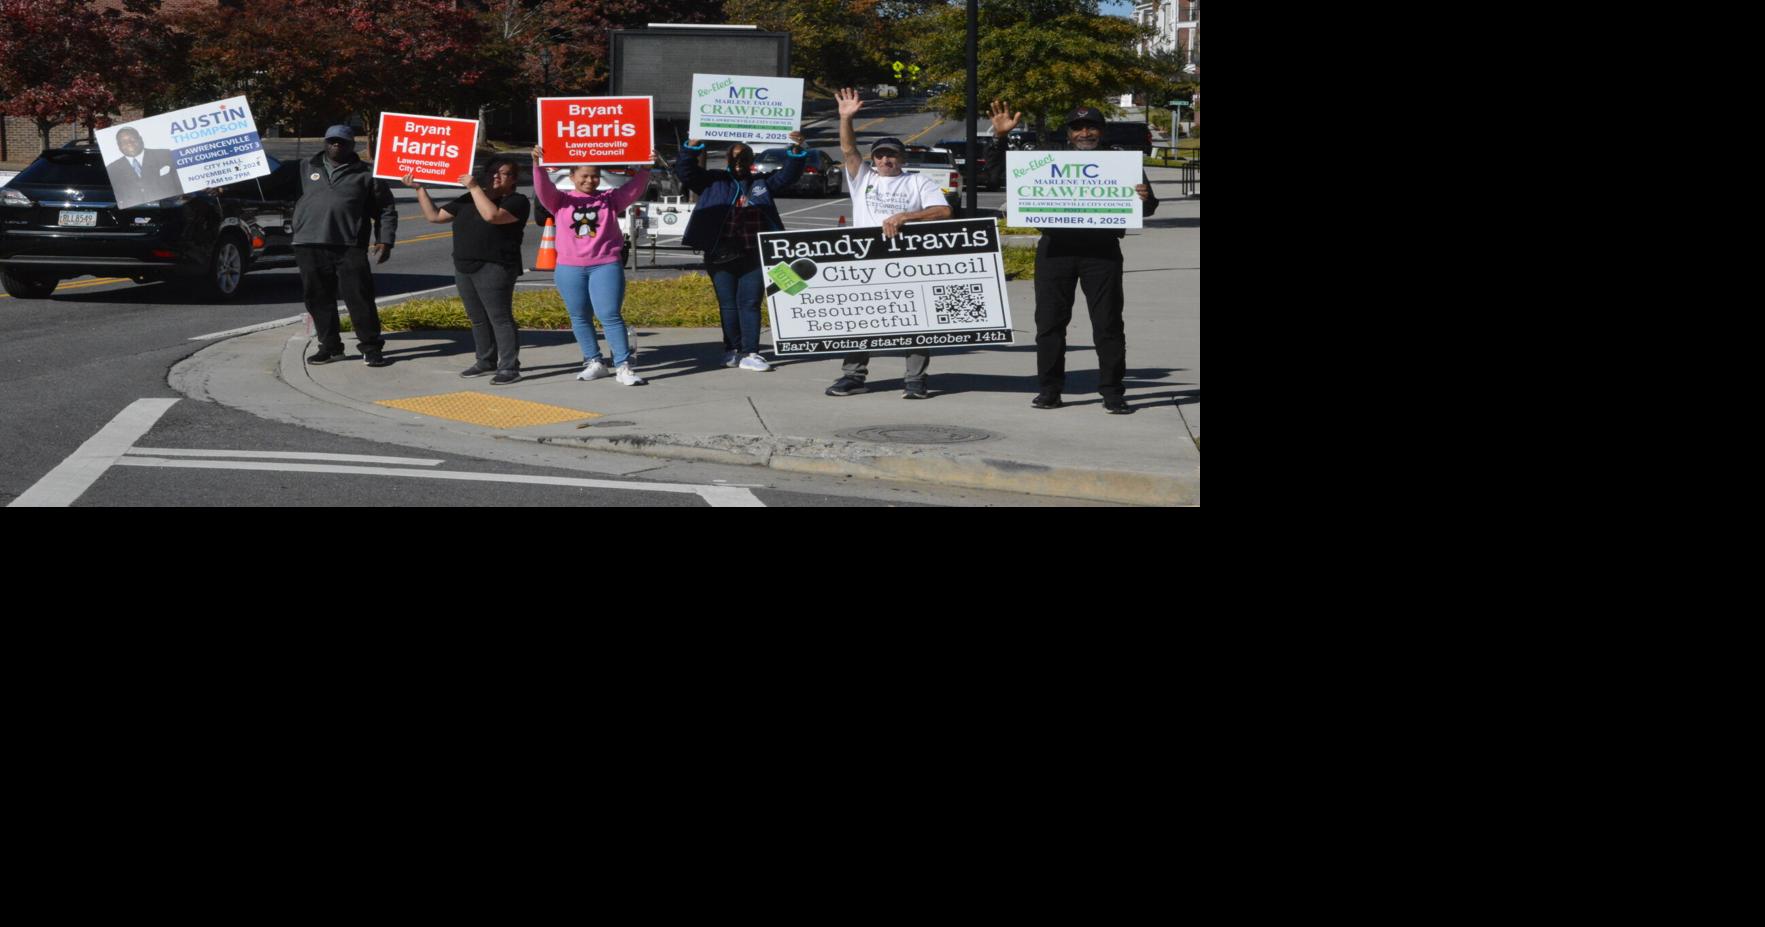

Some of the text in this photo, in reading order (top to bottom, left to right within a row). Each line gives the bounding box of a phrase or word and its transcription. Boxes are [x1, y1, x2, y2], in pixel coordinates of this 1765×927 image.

[697, 78, 733, 97] Re-Elect
[729, 86, 768, 100] MTC
[569, 104, 623, 118] Bryant
[700, 104, 796, 117] CRAWFORD
[171, 105, 246, 135] AUSTIN
[172, 120, 248, 143] THOMPSON
[405, 121, 451, 136] Bryant
[557, 120, 636, 138] Harris
[179, 135, 250, 157] LAWRENCEVILLE
[392, 136, 459, 158] Harris
[565, 141, 628, 149] Lawrenceville
[569, 149, 587, 157] City
[176, 156, 194, 167] CITY
[195, 150, 229, 162] COUNCIL
[234, 143, 254, 153] POST
[223, 158, 243, 167] HALL
[397, 157, 450, 168] Lawrenceville
[399, 165, 446, 175] City Council
[1012, 153, 1055, 178] Re-Elect
[1051, 163, 1099, 178] MTC
[188, 168, 232, 181] NOVEMBER
[207, 177, 223, 185] 7AM
[234, 171, 250, 180] 7PM
[1017, 185, 1135, 198] CRAWFORD
[1025, 216, 1126, 225] NOVEMBER 4, 2025
[769, 227, 989, 259] Randy Travis
[822, 257, 988, 284] City Council
[800, 288, 915, 306] Responsive
[791, 301, 917, 319] Resourceful
[807, 314, 919, 333] Respectful
[781, 331, 1006, 353] Early Voting starts October 14th
